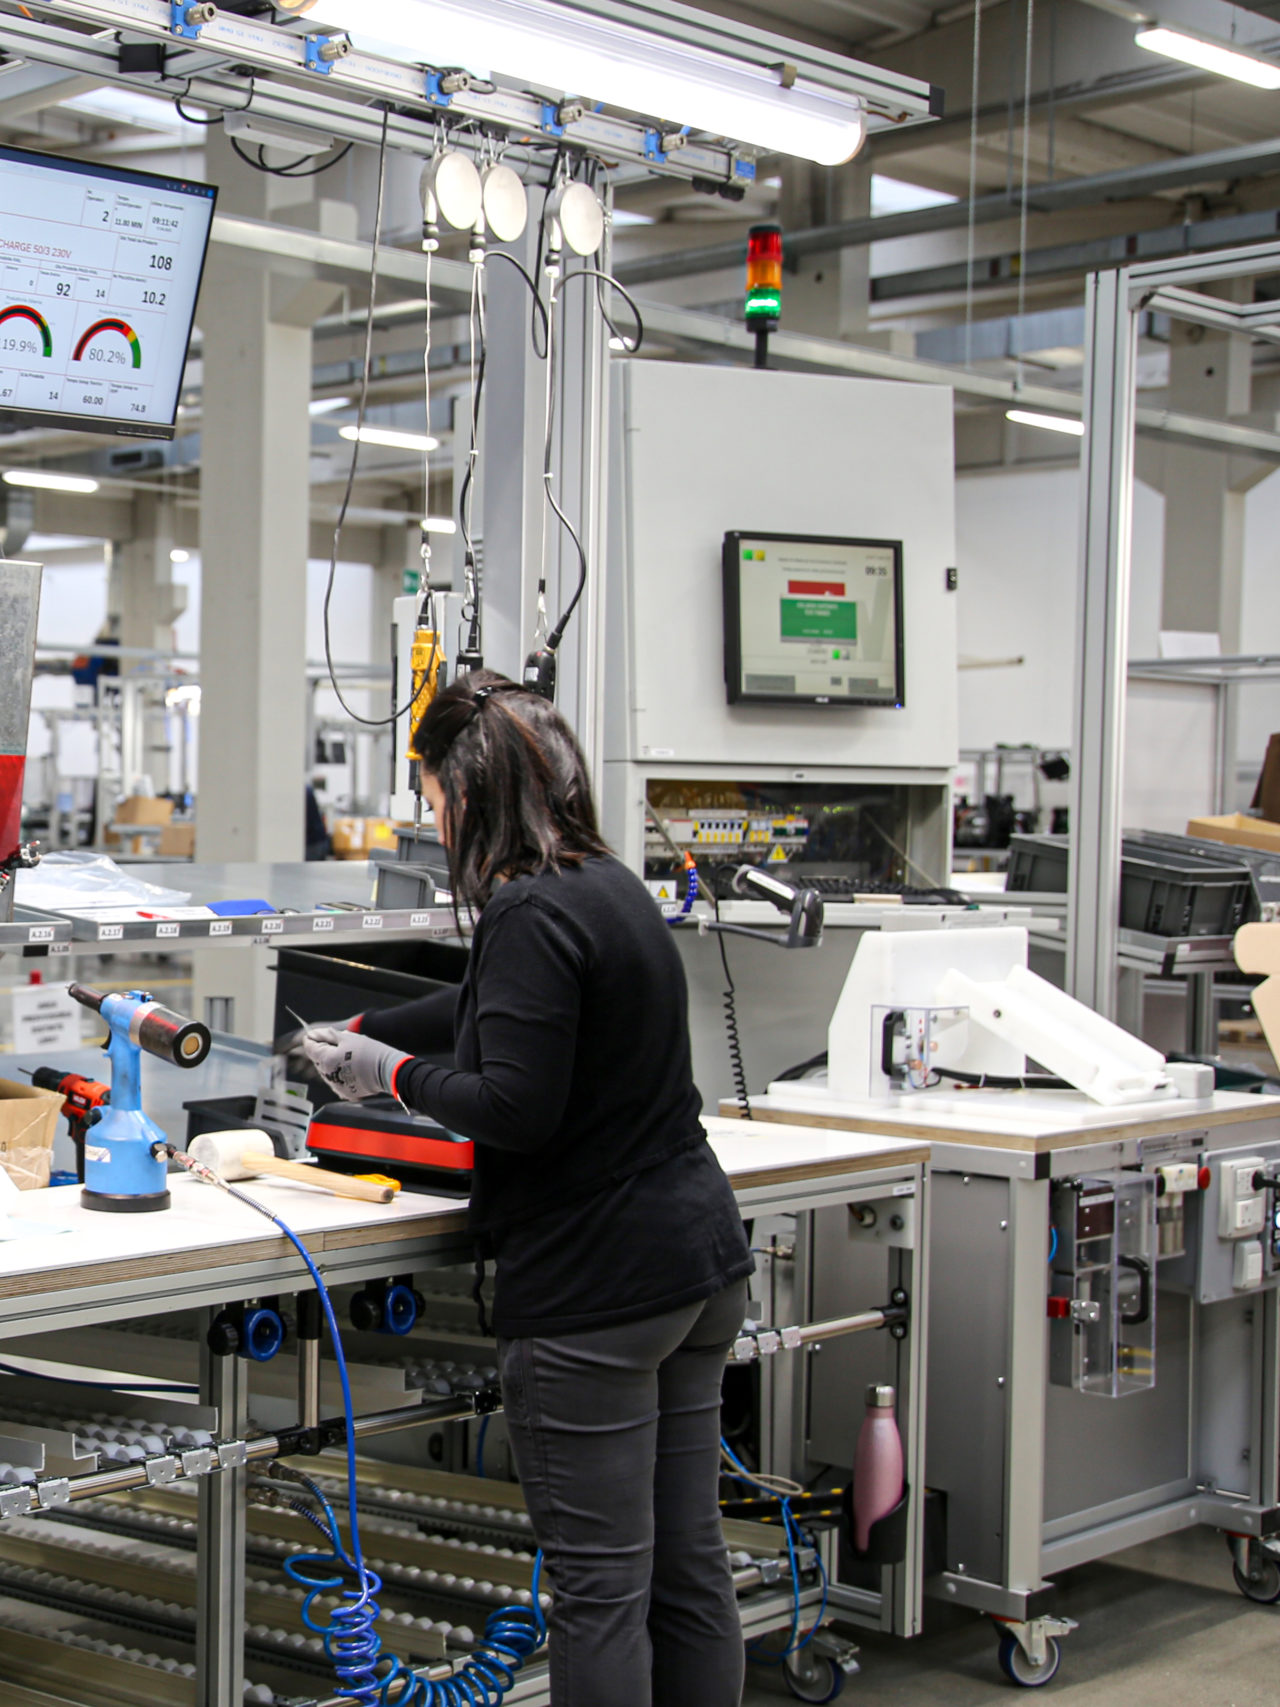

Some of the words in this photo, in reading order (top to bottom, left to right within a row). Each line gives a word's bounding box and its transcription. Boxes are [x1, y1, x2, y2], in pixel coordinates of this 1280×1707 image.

[102, 211, 109, 222] 2
[33, 244, 50, 256] 50/3
[51, 247, 72, 259] 230V
[149, 254, 172, 271] 108
[56, 282, 71, 297] 92
[96, 289, 105, 298] 14
[141, 291, 166, 306] 10.2
[88, 347, 126, 365] 80.2%
[49, 391, 58, 400] 14
[101, 928, 120, 937] A.2.17
